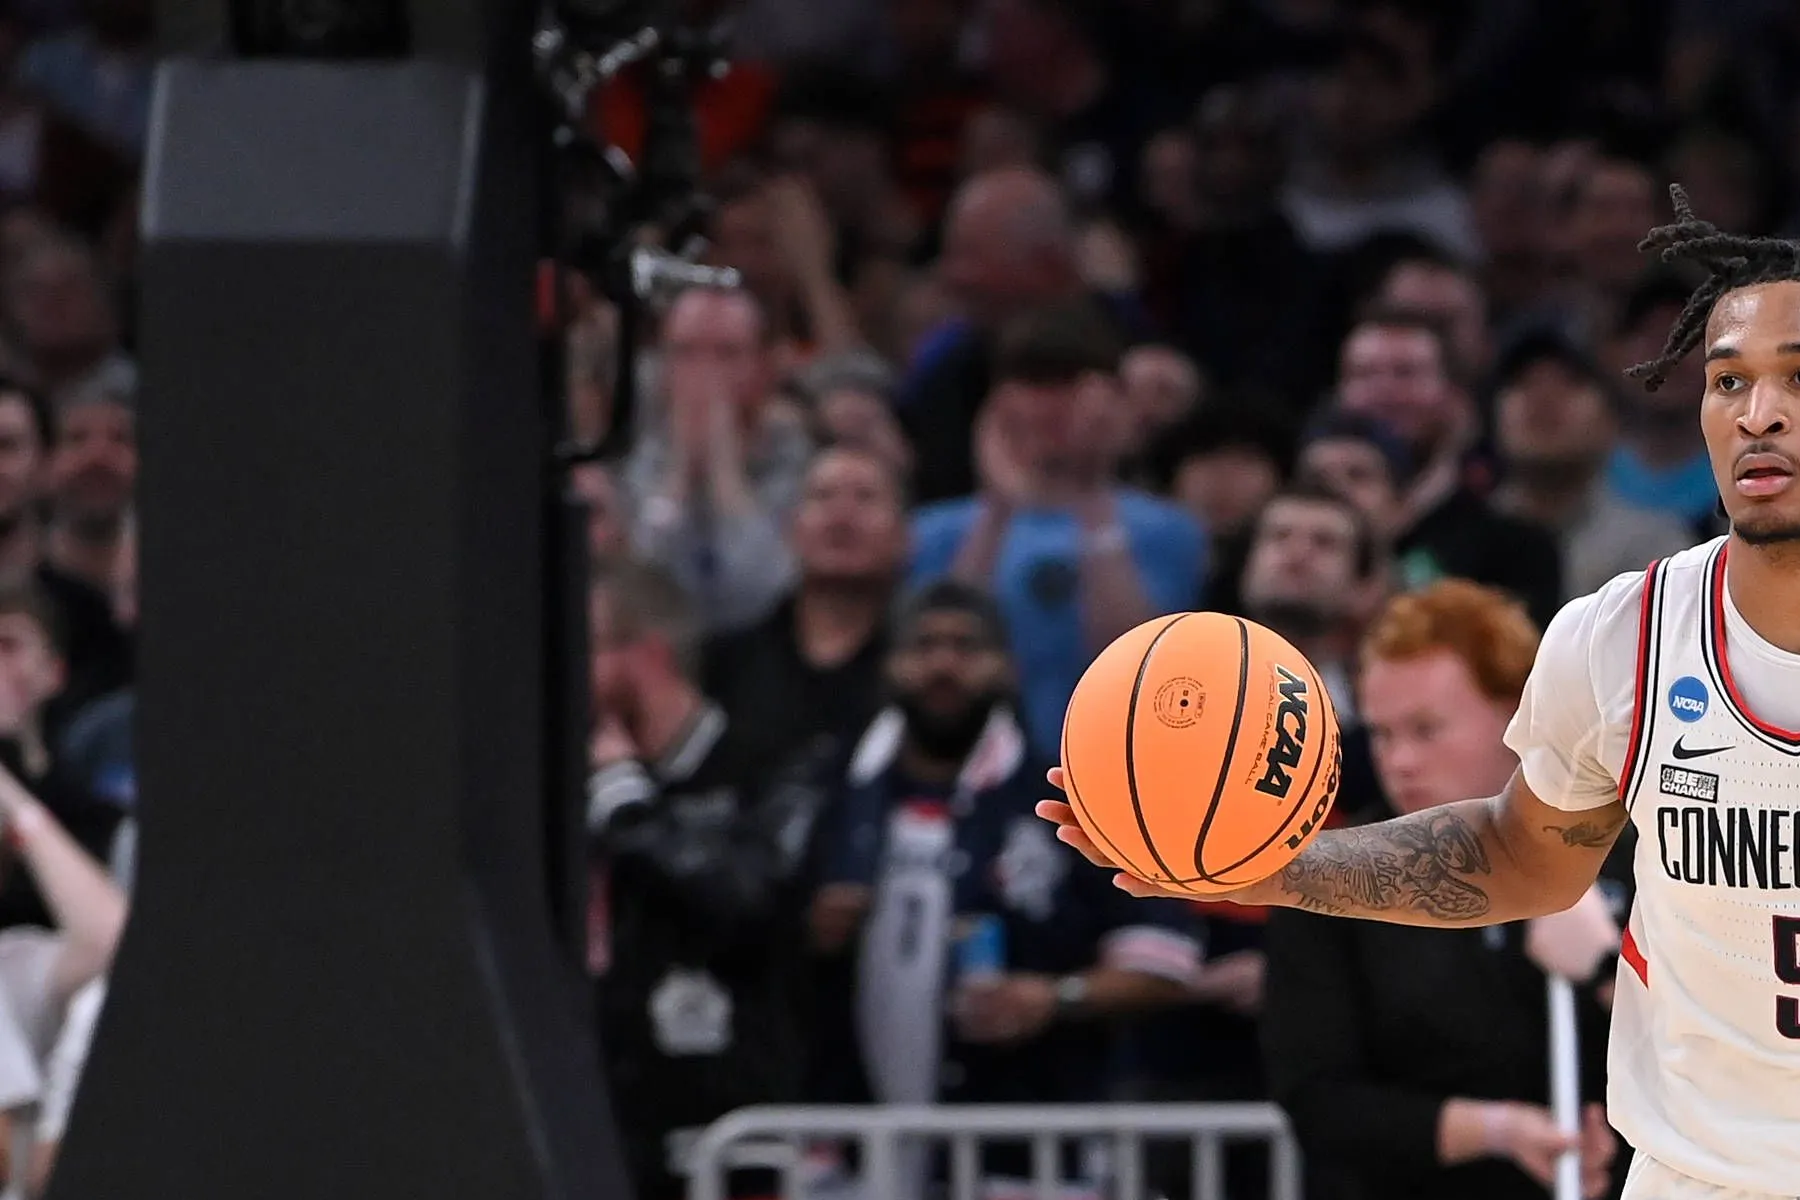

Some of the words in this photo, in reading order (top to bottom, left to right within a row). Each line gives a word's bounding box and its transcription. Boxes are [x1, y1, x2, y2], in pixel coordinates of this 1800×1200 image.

[1672, 695, 1705, 715] NCAA
[1255, 666, 1308, 798] NCAA
[1245, 752, 1262, 785] BALL
[1661, 781, 1716, 800] CHANGE
